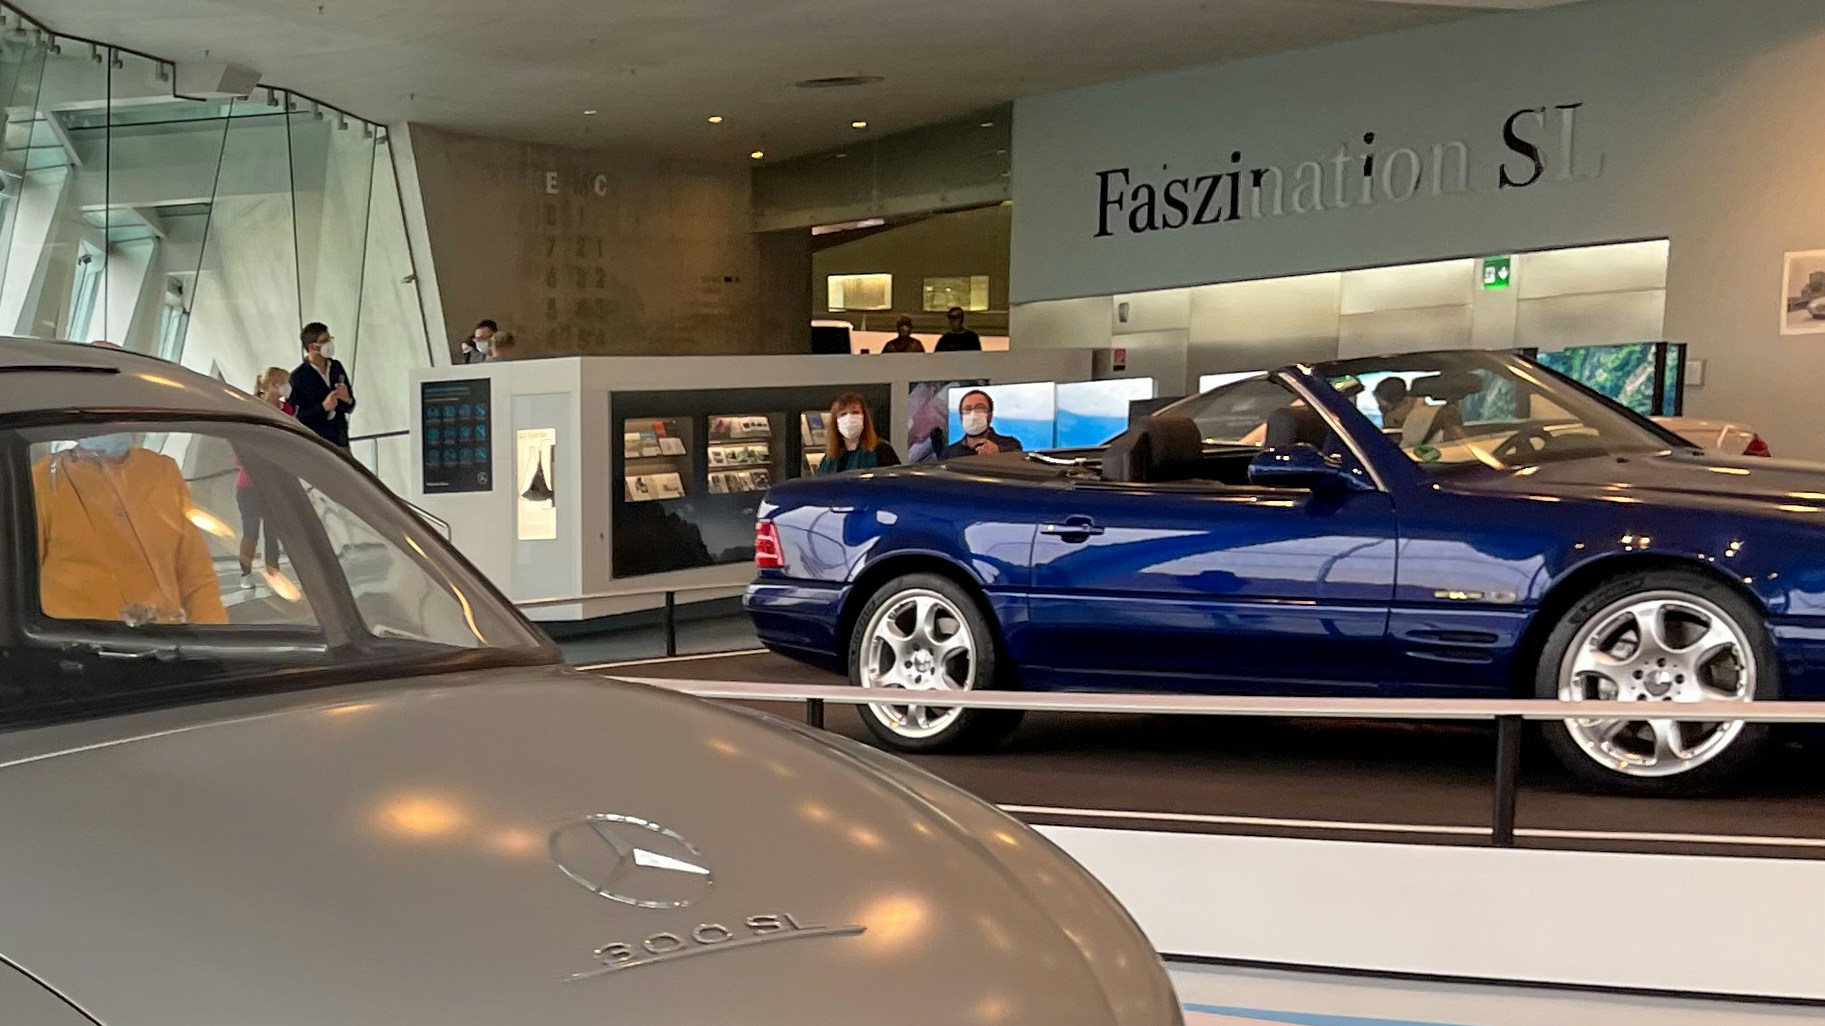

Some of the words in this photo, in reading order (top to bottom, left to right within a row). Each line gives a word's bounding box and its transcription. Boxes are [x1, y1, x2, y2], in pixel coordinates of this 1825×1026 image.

[545, 171, 558, 194] E
[594, 174, 608, 197] C
[1093, 131, 1474, 238] Faszination
[1498, 102, 1604, 190] SL
[593, 923, 733, 966] 300
[745, 912, 827, 936] SL
